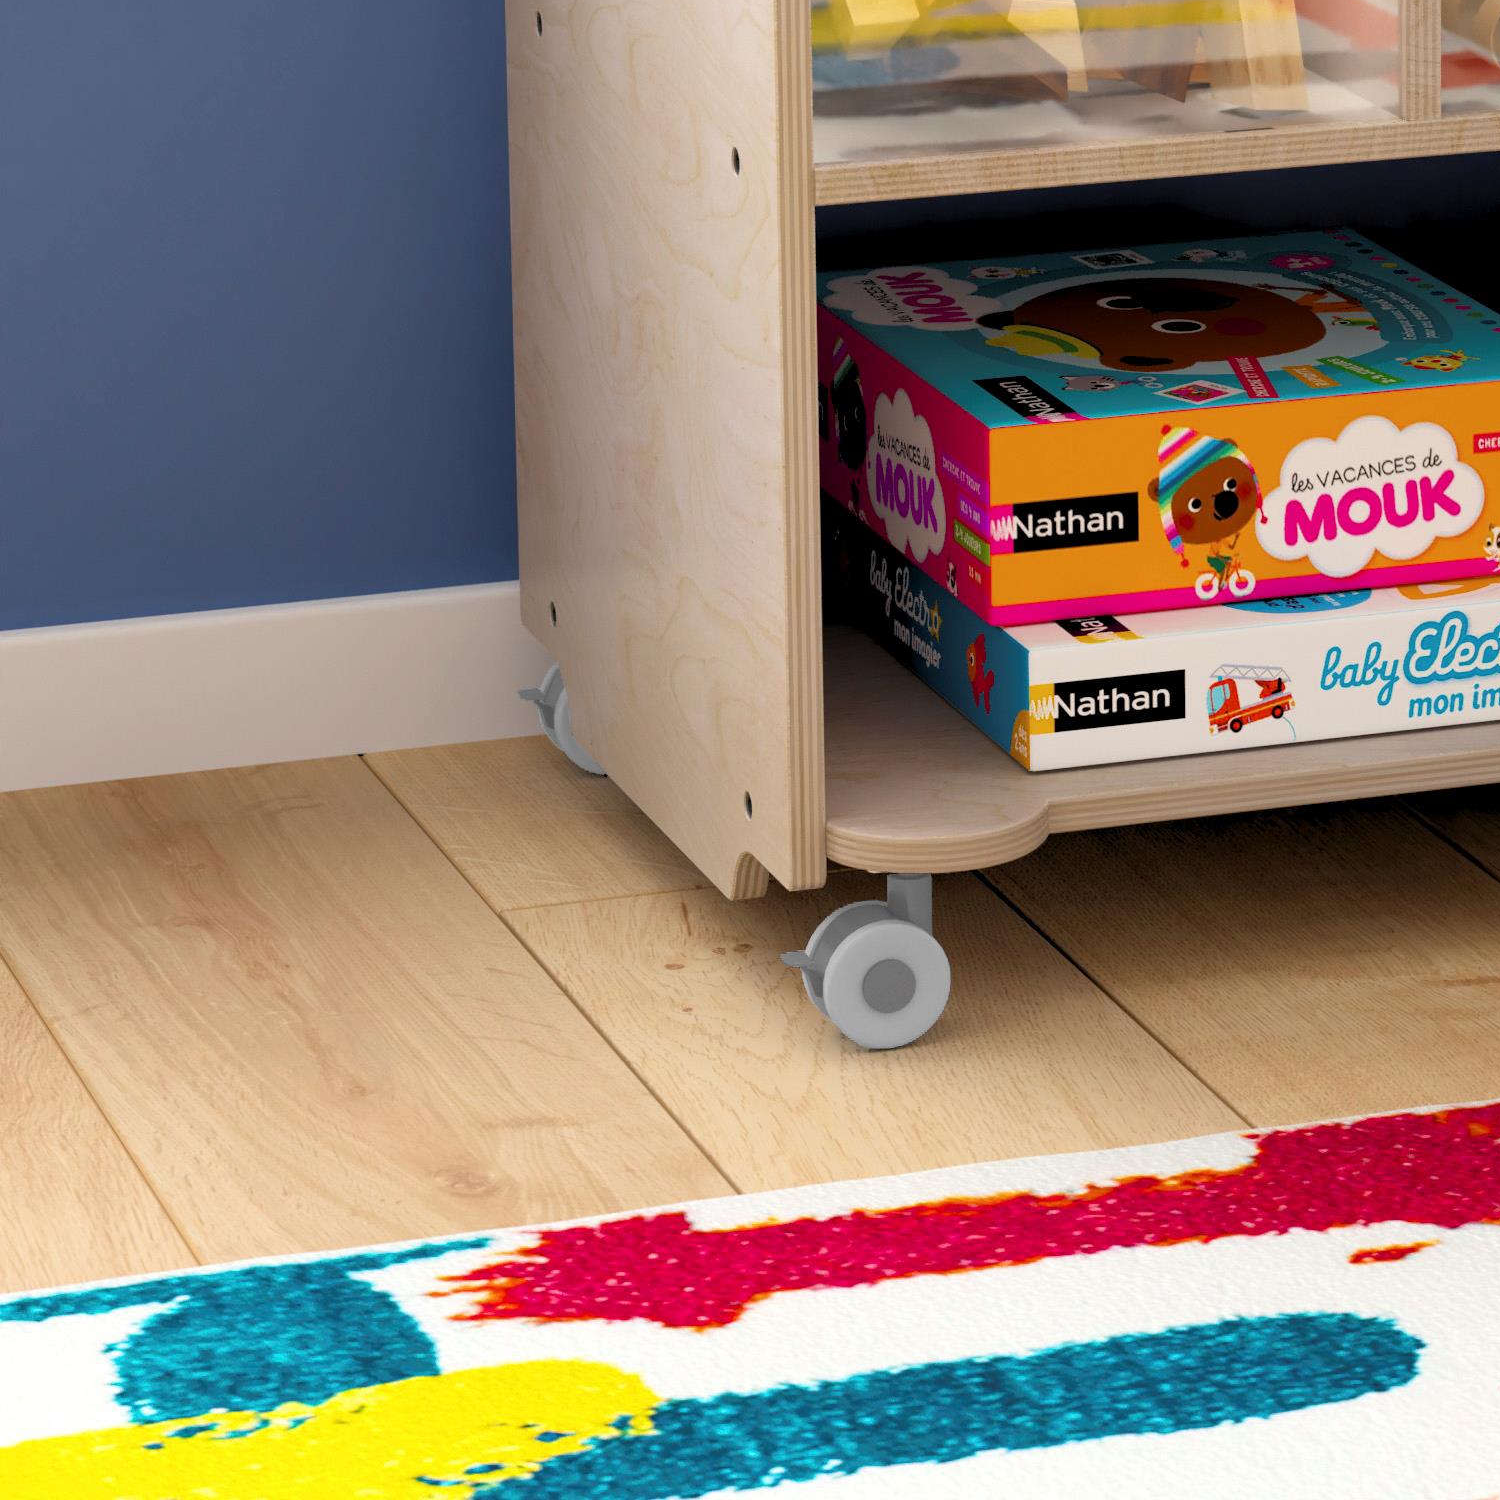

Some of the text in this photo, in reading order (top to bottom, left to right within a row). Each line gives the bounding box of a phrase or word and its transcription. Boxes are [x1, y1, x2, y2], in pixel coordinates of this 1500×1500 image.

[876, 271, 974, 324] MOUK
[999, 381, 1057, 420] Nathan
[887, 432, 922, 465] VACANCES
[1291, 448, 1443, 494] les VACANCES de
[876, 451, 938, 533] MOUK
[1284, 469, 1462, 546] MOUK
[1013, 509, 1125, 540] Nathan
[870, 550, 942, 638] baby Electro
[894, 618, 942, 669] mon imagier
[1320, 641, 1400, 706] baby
[1053, 687, 1171, 720] Nathan
[1408, 692, 1464, 718] mon
